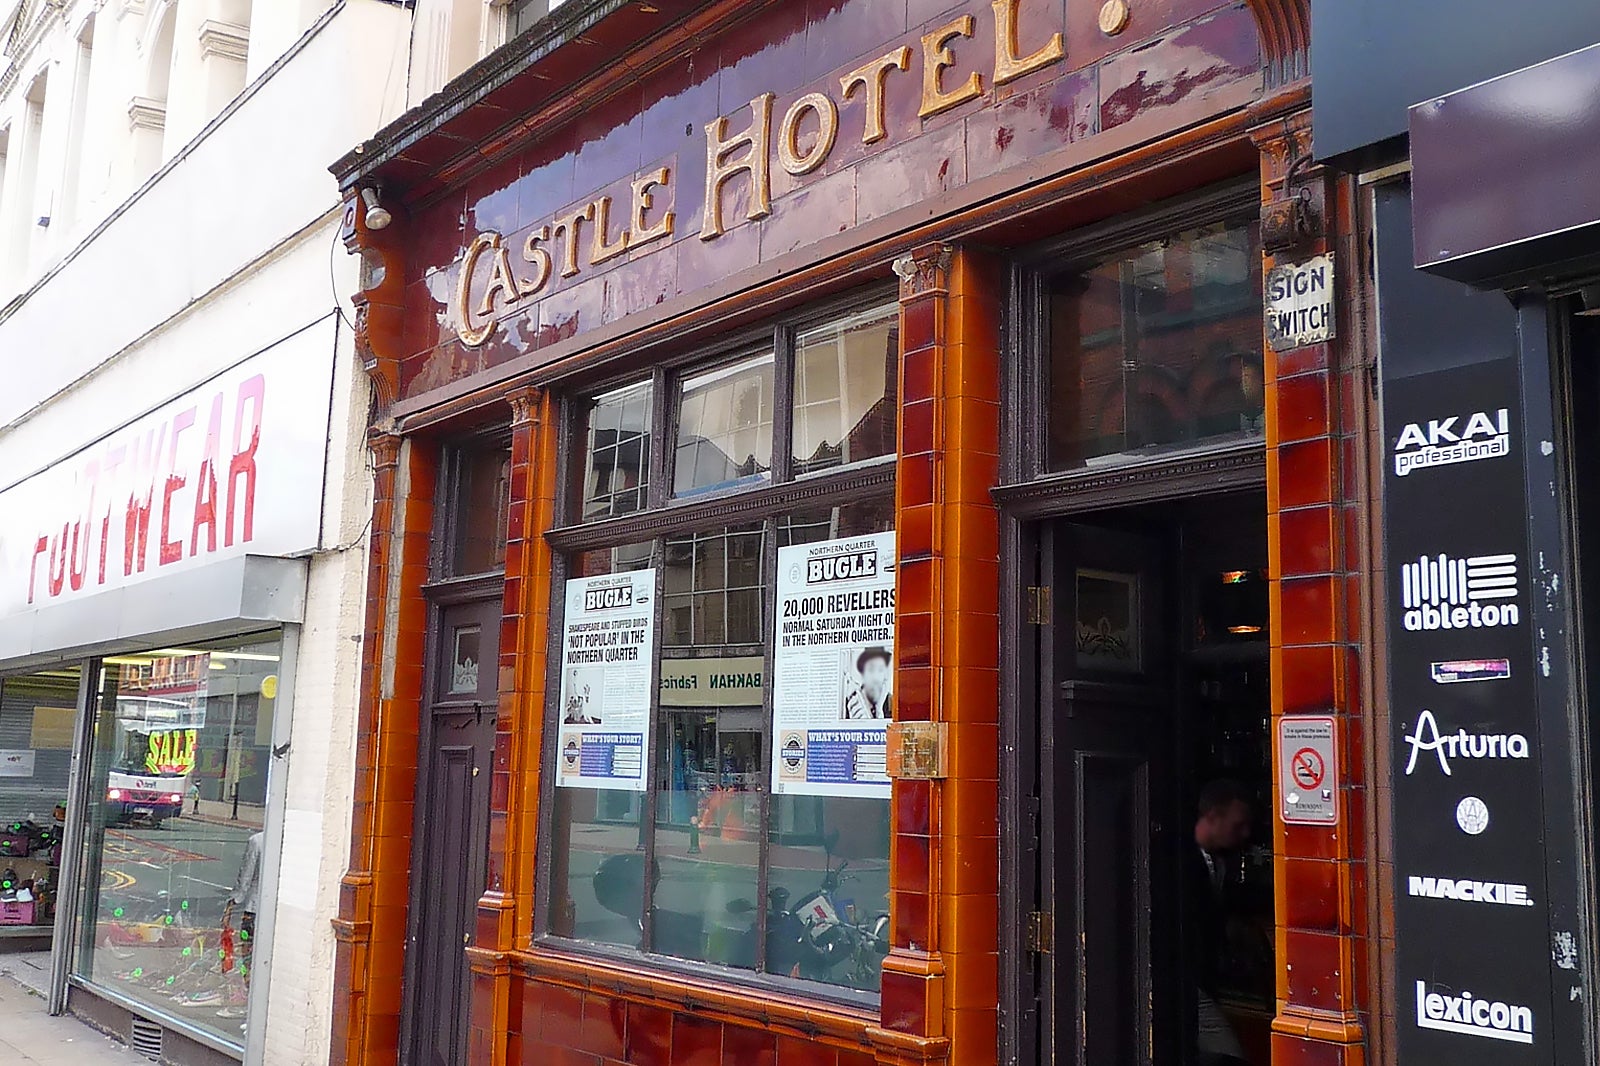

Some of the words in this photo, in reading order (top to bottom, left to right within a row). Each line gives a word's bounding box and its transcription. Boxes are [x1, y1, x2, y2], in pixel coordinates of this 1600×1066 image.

[456, 167, 674, 347] CASTLE
[1271, 267, 1325, 301] SIGN
[1269, 303, 1330, 339] SWITCH
[1395, 408, 1508, 450] AKAI
[1399, 438, 1506, 473] professional
[809, 545, 844, 556] NORTHERN
[845, 540, 876, 552] QUARTER
[809, 553, 875, 582] BUGLE
[586, 587, 632, 609] BUGLE
[783, 596, 824, 620] 20,000
[827, 588, 896, 613] REVELLERS
[568, 622, 600, 633] SHAKESPEARE
[782, 619, 814, 634] NORMAL
[816, 616, 856, 631] SATURDAY
[858, 613, 883, 627] NIGHT
[1404, 601, 1519, 631] ableton
[621, 630, 629, 645] IN
[631, 629, 645, 644] THE
[782, 635, 791, 647] IN
[792, 634, 806, 646] THE
[808, 631, 849, 646] NORTHERN
[567, 648, 603, 664] NORTHERN
[605, 647, 638, 663] QUARTER
[148, 729, 196, 766] SALE
[808, 732, 840, 742] WHAT'S
[840, 732, 862, 742] YOUR
[1404, 710, 1530, 776] Arturia
[1416, 980, 1533, 1044] Lexicon
